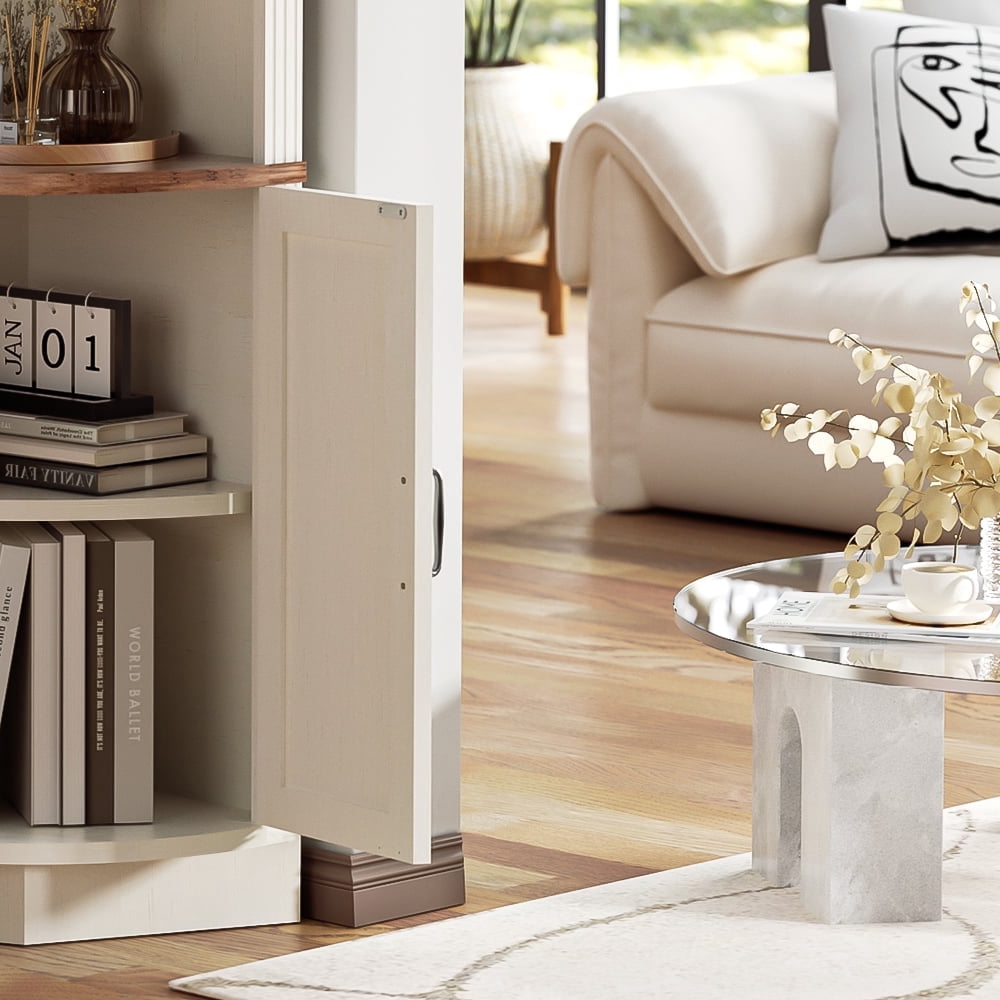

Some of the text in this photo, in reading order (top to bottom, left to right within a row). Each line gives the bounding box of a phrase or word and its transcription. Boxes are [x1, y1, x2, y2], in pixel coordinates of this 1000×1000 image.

[4, 318, 23, 375] JAN
[0, 585, 13, 623] glance
[128, 626, 141, 743] WORLD BALLET
